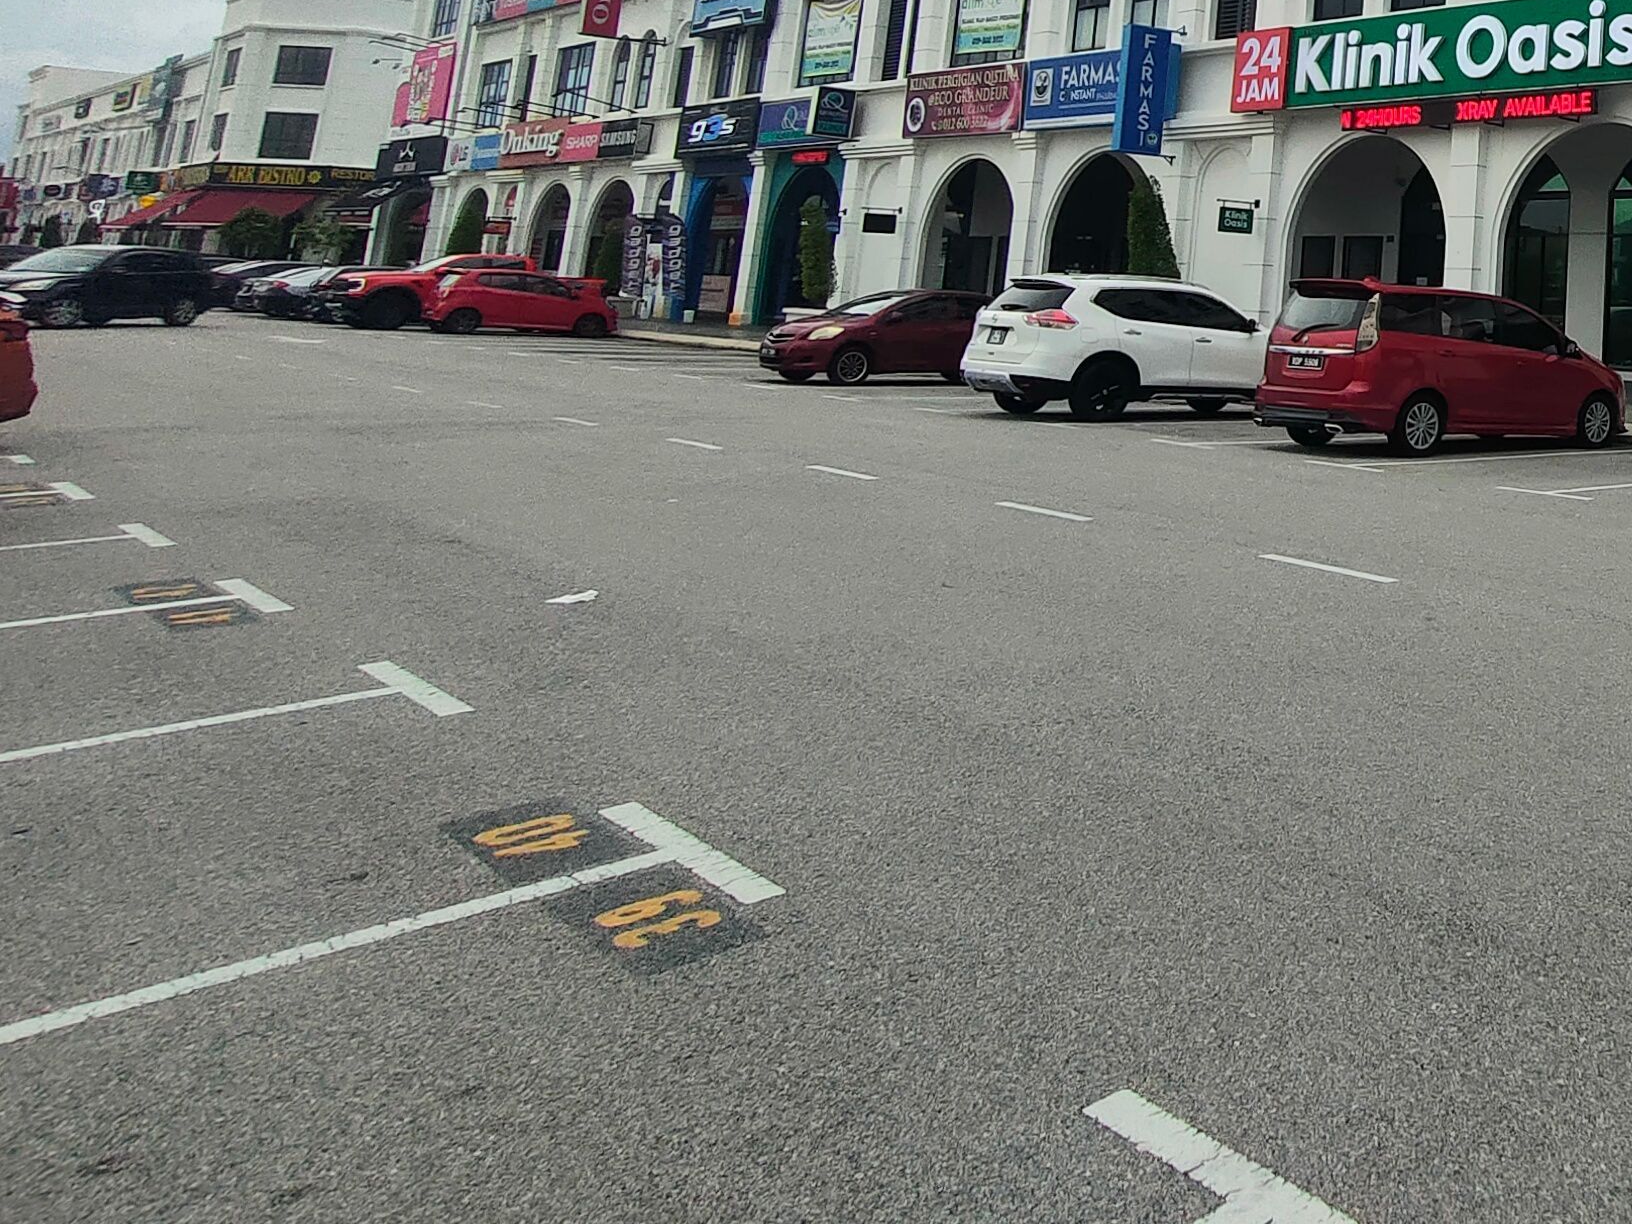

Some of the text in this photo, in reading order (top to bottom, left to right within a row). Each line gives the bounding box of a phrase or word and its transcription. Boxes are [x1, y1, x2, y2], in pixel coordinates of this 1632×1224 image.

[1239, 35, 1282, 77] 24
[1294, 22, 1446, 94] Klinik
[909, 67, 1020, 91] KLINIK PERGIGIAN QISTINA
[1137, 33, 1158, 147] FARMASI
[1236, 77, 1280, 104] JAM
[954, 86, 1010, 103] GRANDEUR
[967, 103, 994, 115] CLINIC
[1356, 104, 1422, 128] 24HOURS
[1455, 98, 1498, 121] XRAY
[1502, 90, 1593, 118] AVAILABLE
[601, 129, 637, 146] SAMSUNG
[687, 112, 741, 144] g3s
[500, 125, 563, 157] Onking
[565, 134, 598, 150] SHARP
[1223, 218, 1248, 229] Oasis
[1224, 210, 1249, 220] Klinik
